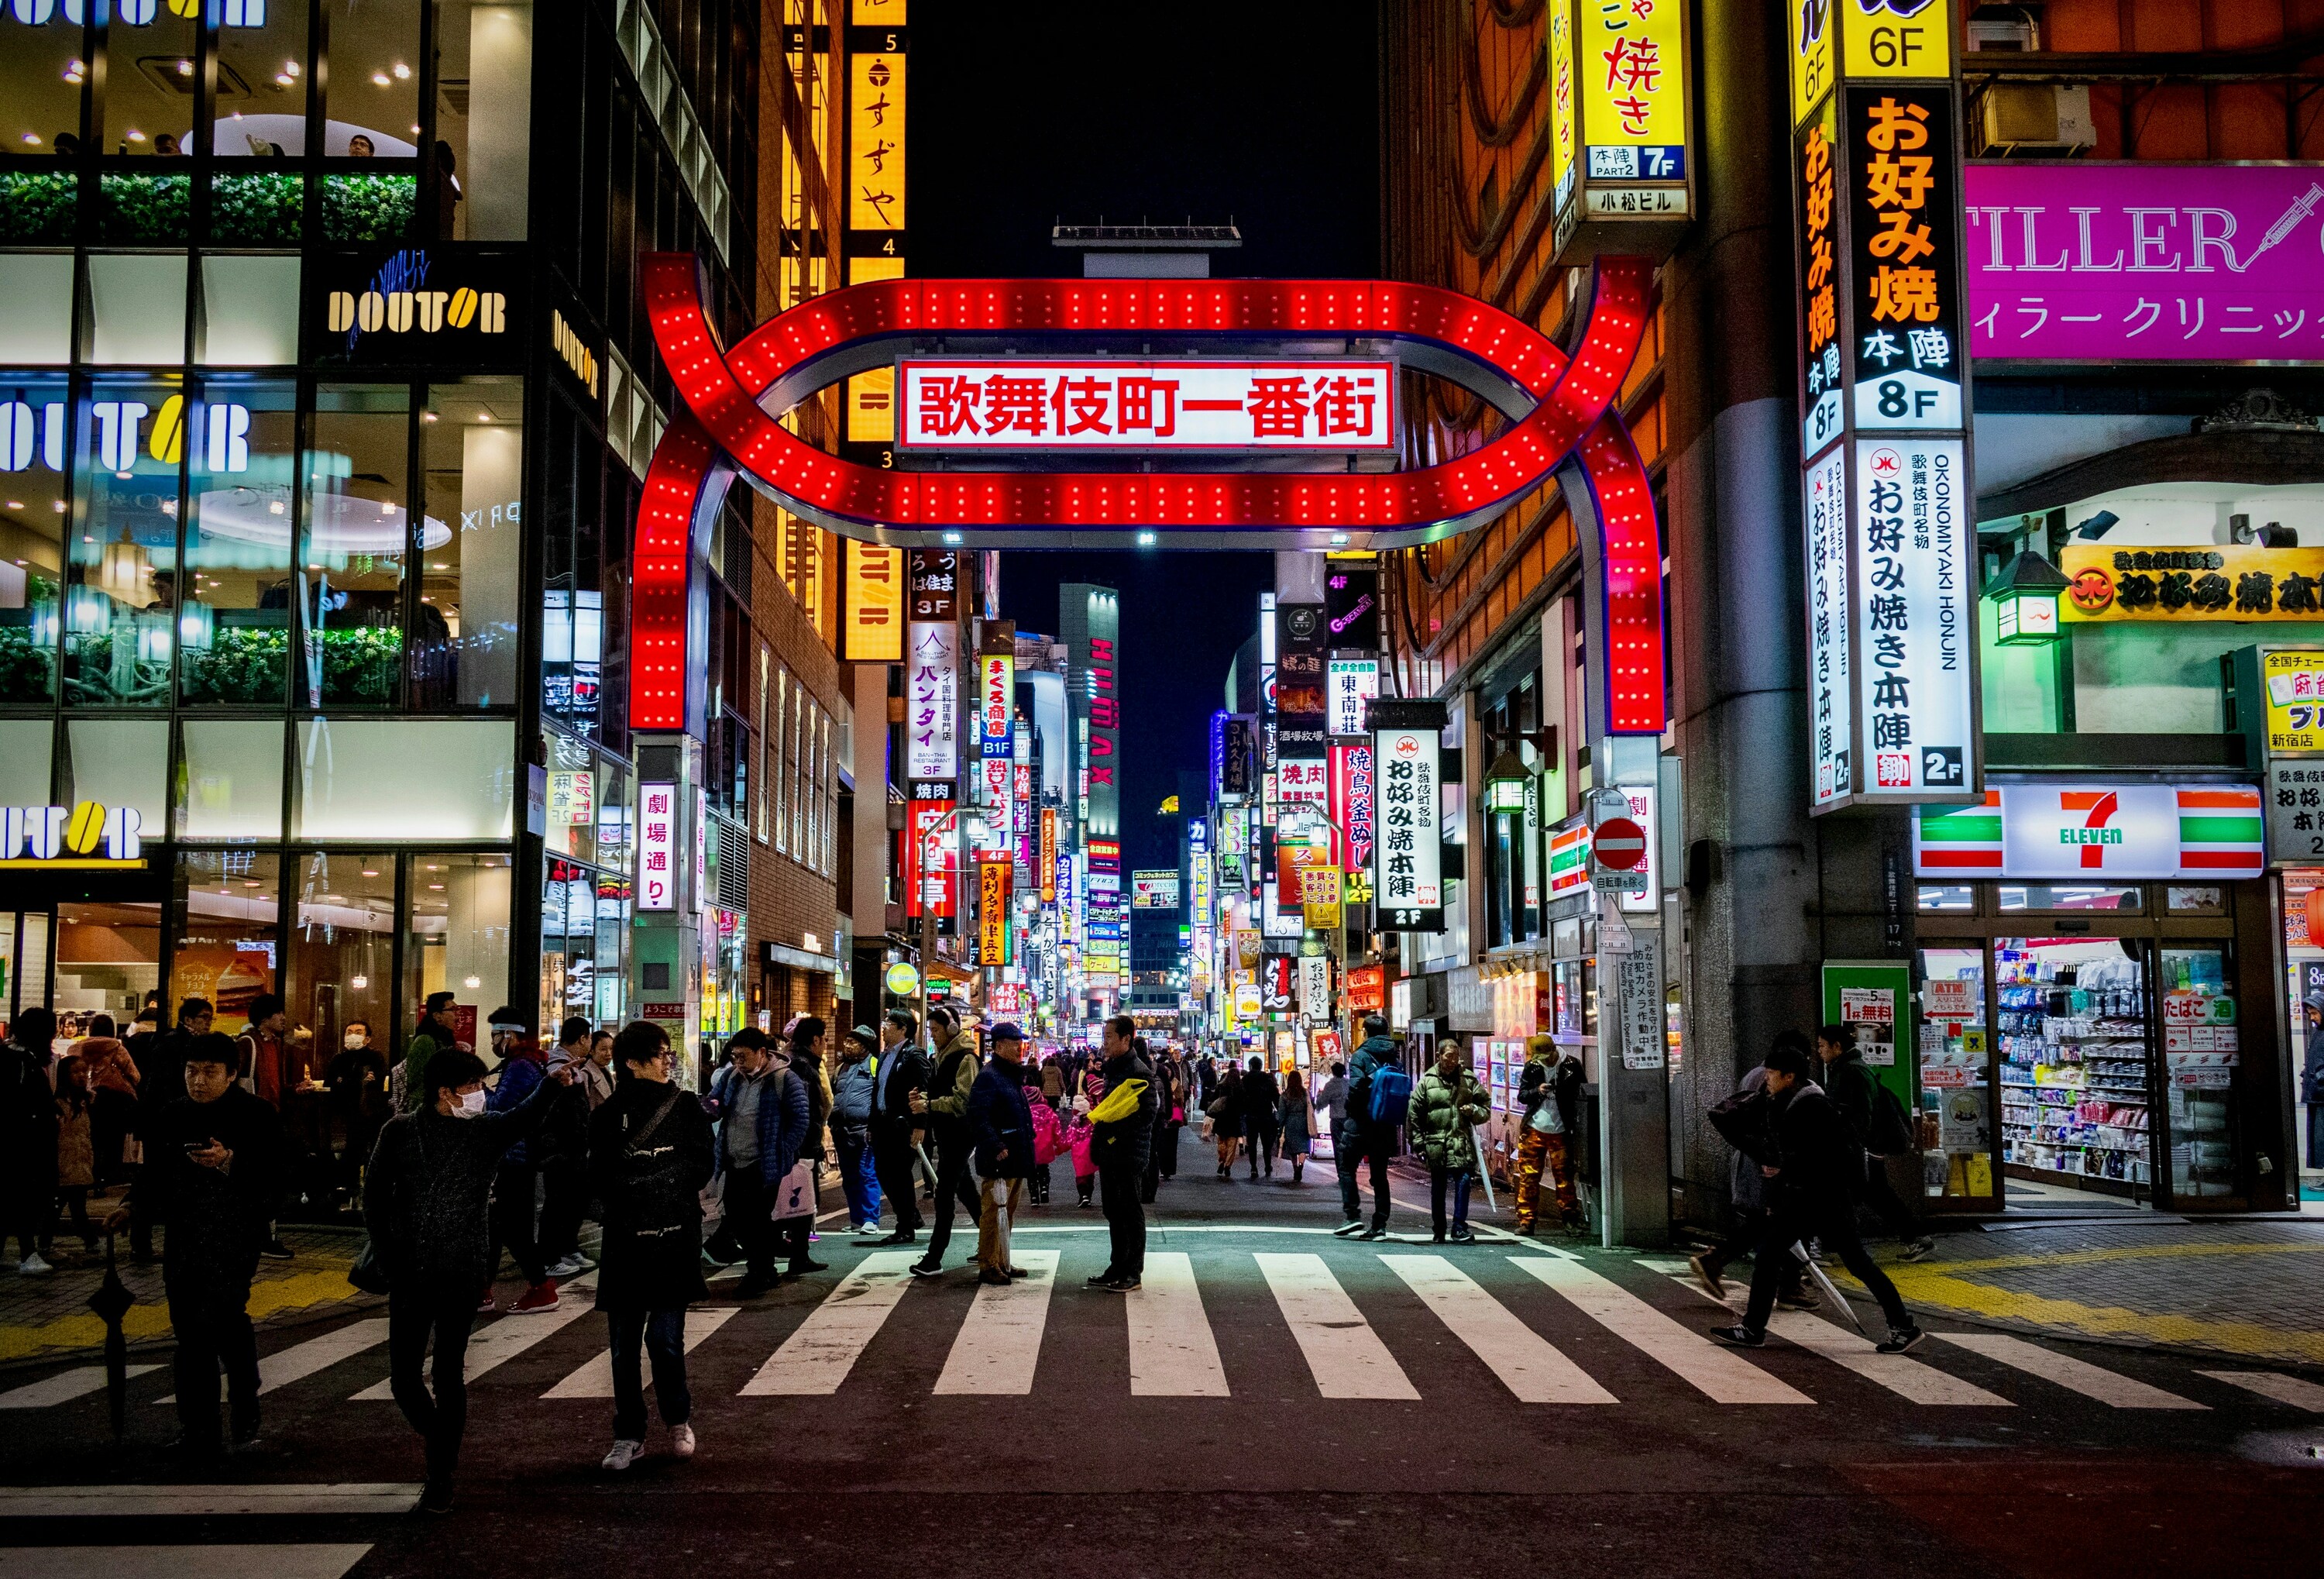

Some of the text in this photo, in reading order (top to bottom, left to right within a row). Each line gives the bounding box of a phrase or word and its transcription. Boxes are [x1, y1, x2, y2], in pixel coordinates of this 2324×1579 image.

[885, 34, 896, 50] 5
[1869, 26, 1924, 67] 6F
[1603, 36, 1662, 135] 焼き
[1805, 43, 1825, 102] 6F
[862, 92, 896, 225] すずや
[1595, 148, 1630, 164] 本陣
[1596, 164, 1634, 176] PART2
[1644, 147, 1675, 176] 7F
[1601, 192, 1671, 212] 小松ビル
[1867, 97, 1941, 322] お好み焼
[883, 239, 895, 255] 4
[1805, 122, 1837, 353] お好み焼
[1965, 207, 2246, 273] ILLER
[328, 287, 506, 333] DOUTOR
[2123, 297, 2324, 339] クリニッ
[553, 308, 599, 401] DOUTOR
[1863, 327, 1950, 370] 本陣
[1809, 342, 1840, 395] 本陣
[920, 374, 1376, 439] 歌舞伎町一番街
[1878, 380, 1939, 418] 8F
[1816, 401, 1837, 441] 8F
[882, 451, 892, 469] 3
[1911, 454, 1929, 549] 歌舞伎町名物
[1934, 454, 1956, 671] OKONOMIYAKI HONJIN
[1329, 576, 1348, 589] 4F
[917, 600, 951, 614] 3F
[1867, 480, 1913, 751] お好み焼き本陣
[1330, 662, 1376, 673] 全卓全自動
[915, 666, 939, 747] バンタイ
[942, 666, 952, 741] タイ国料理専門店
[988, 659, 1006, 737] まぐろ商店
[1341, 675, 1357, 734] 東南荘
[983, 741, 1010, 754] B1F
[2271, 734, 2314, 747] 新宿店
[923, 765, 941, 775] 3F
[1836, 756, 1849, 786] 2F
[1925, 752, 1961, 780] 2F
[916, 783, 949, 800] 焼肉
[1387, 759, 1416, 898] お好み焼本陣
[646, 794, 668, 899] 劇場通り
[988, 851, 1006, 861] 4F
[1305, 872, 1336, 882] 悪質な
[1305, 883, 1336, 893] 客引き
[1596, 876, 1645, 889] 自転車を除く
[1305, 894, 1337, 904] に注意
[1349, 889, 1373, 903] 2F
[1395, 909, 1422, 925] 2F
[180, 972, 211, 982] キャラメル
[1934, 983, 1964, 993] ATM
[1634, 950, 1649, 1047] 防犯カメラ作動中
[1645, 944, 1659, 1051] みなさまの安全を守ります
[2164, 999, 2206, 1018] たばこ
[2212, 999, 2232, 1018] 酒
